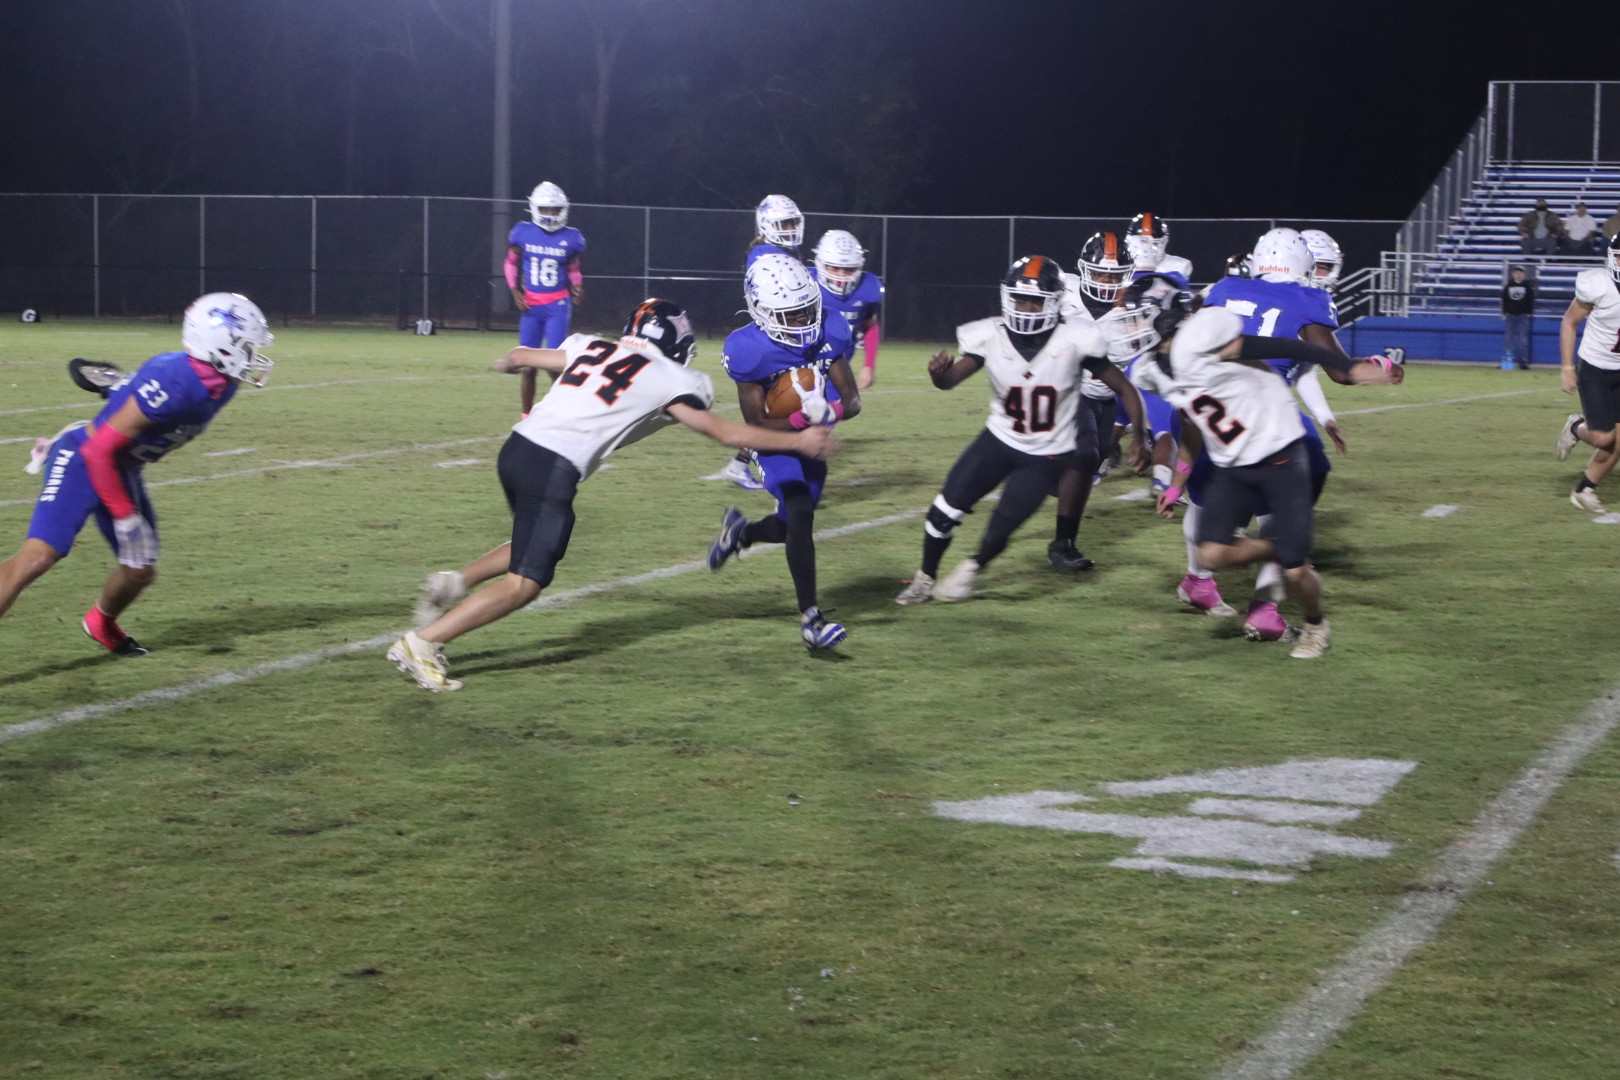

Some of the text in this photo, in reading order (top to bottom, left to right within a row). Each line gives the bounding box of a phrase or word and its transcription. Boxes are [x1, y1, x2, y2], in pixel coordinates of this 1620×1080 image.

[1259, 265, 1290, 274] Riddell
[22, 308, 36, 322] G
[137, 378, 169, 409] 23
[559, 340, 653, 407] 24
[1004, 385, 1058, 434] 40
[1183, 393, 1248, 446] 2
